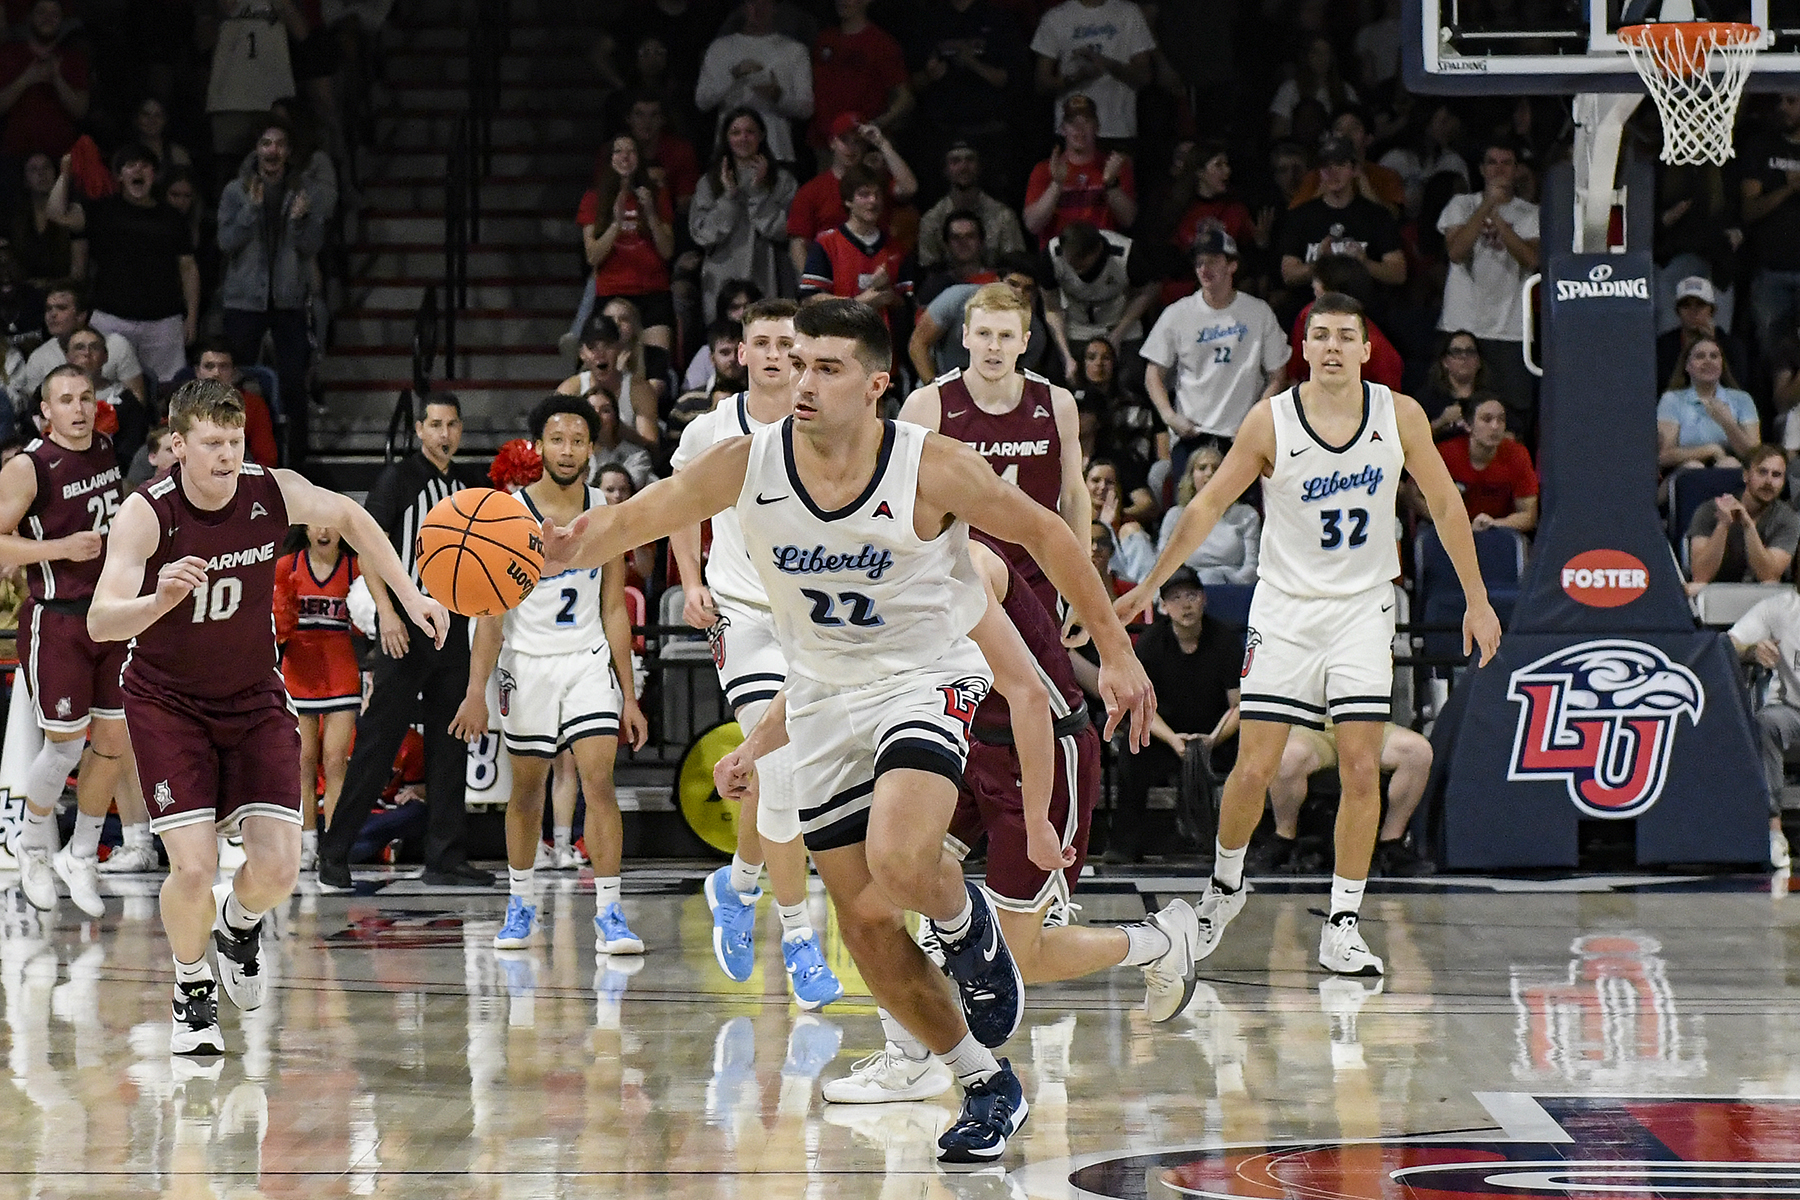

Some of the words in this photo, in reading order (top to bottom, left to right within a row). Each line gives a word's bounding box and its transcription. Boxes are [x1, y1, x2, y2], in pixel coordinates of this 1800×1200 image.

[1556, 277, 1651, 302] SPALDING
[1214, 346, 1232, 364] 22
[62, 465, 122, 500] BELLARMIN
[1300, 464, 1384, 502] Liberty
[86, 488, 121, 536] 25
[1320, 507, 1371, 551] 32
[772, 543, 894, 580] Liberty
[1562, 568, 1648, 589] FOSTER
[191, 576, 243, 624] 10
[556, 587, 578, 626] 2
[799, 587, 886, 628] 22
